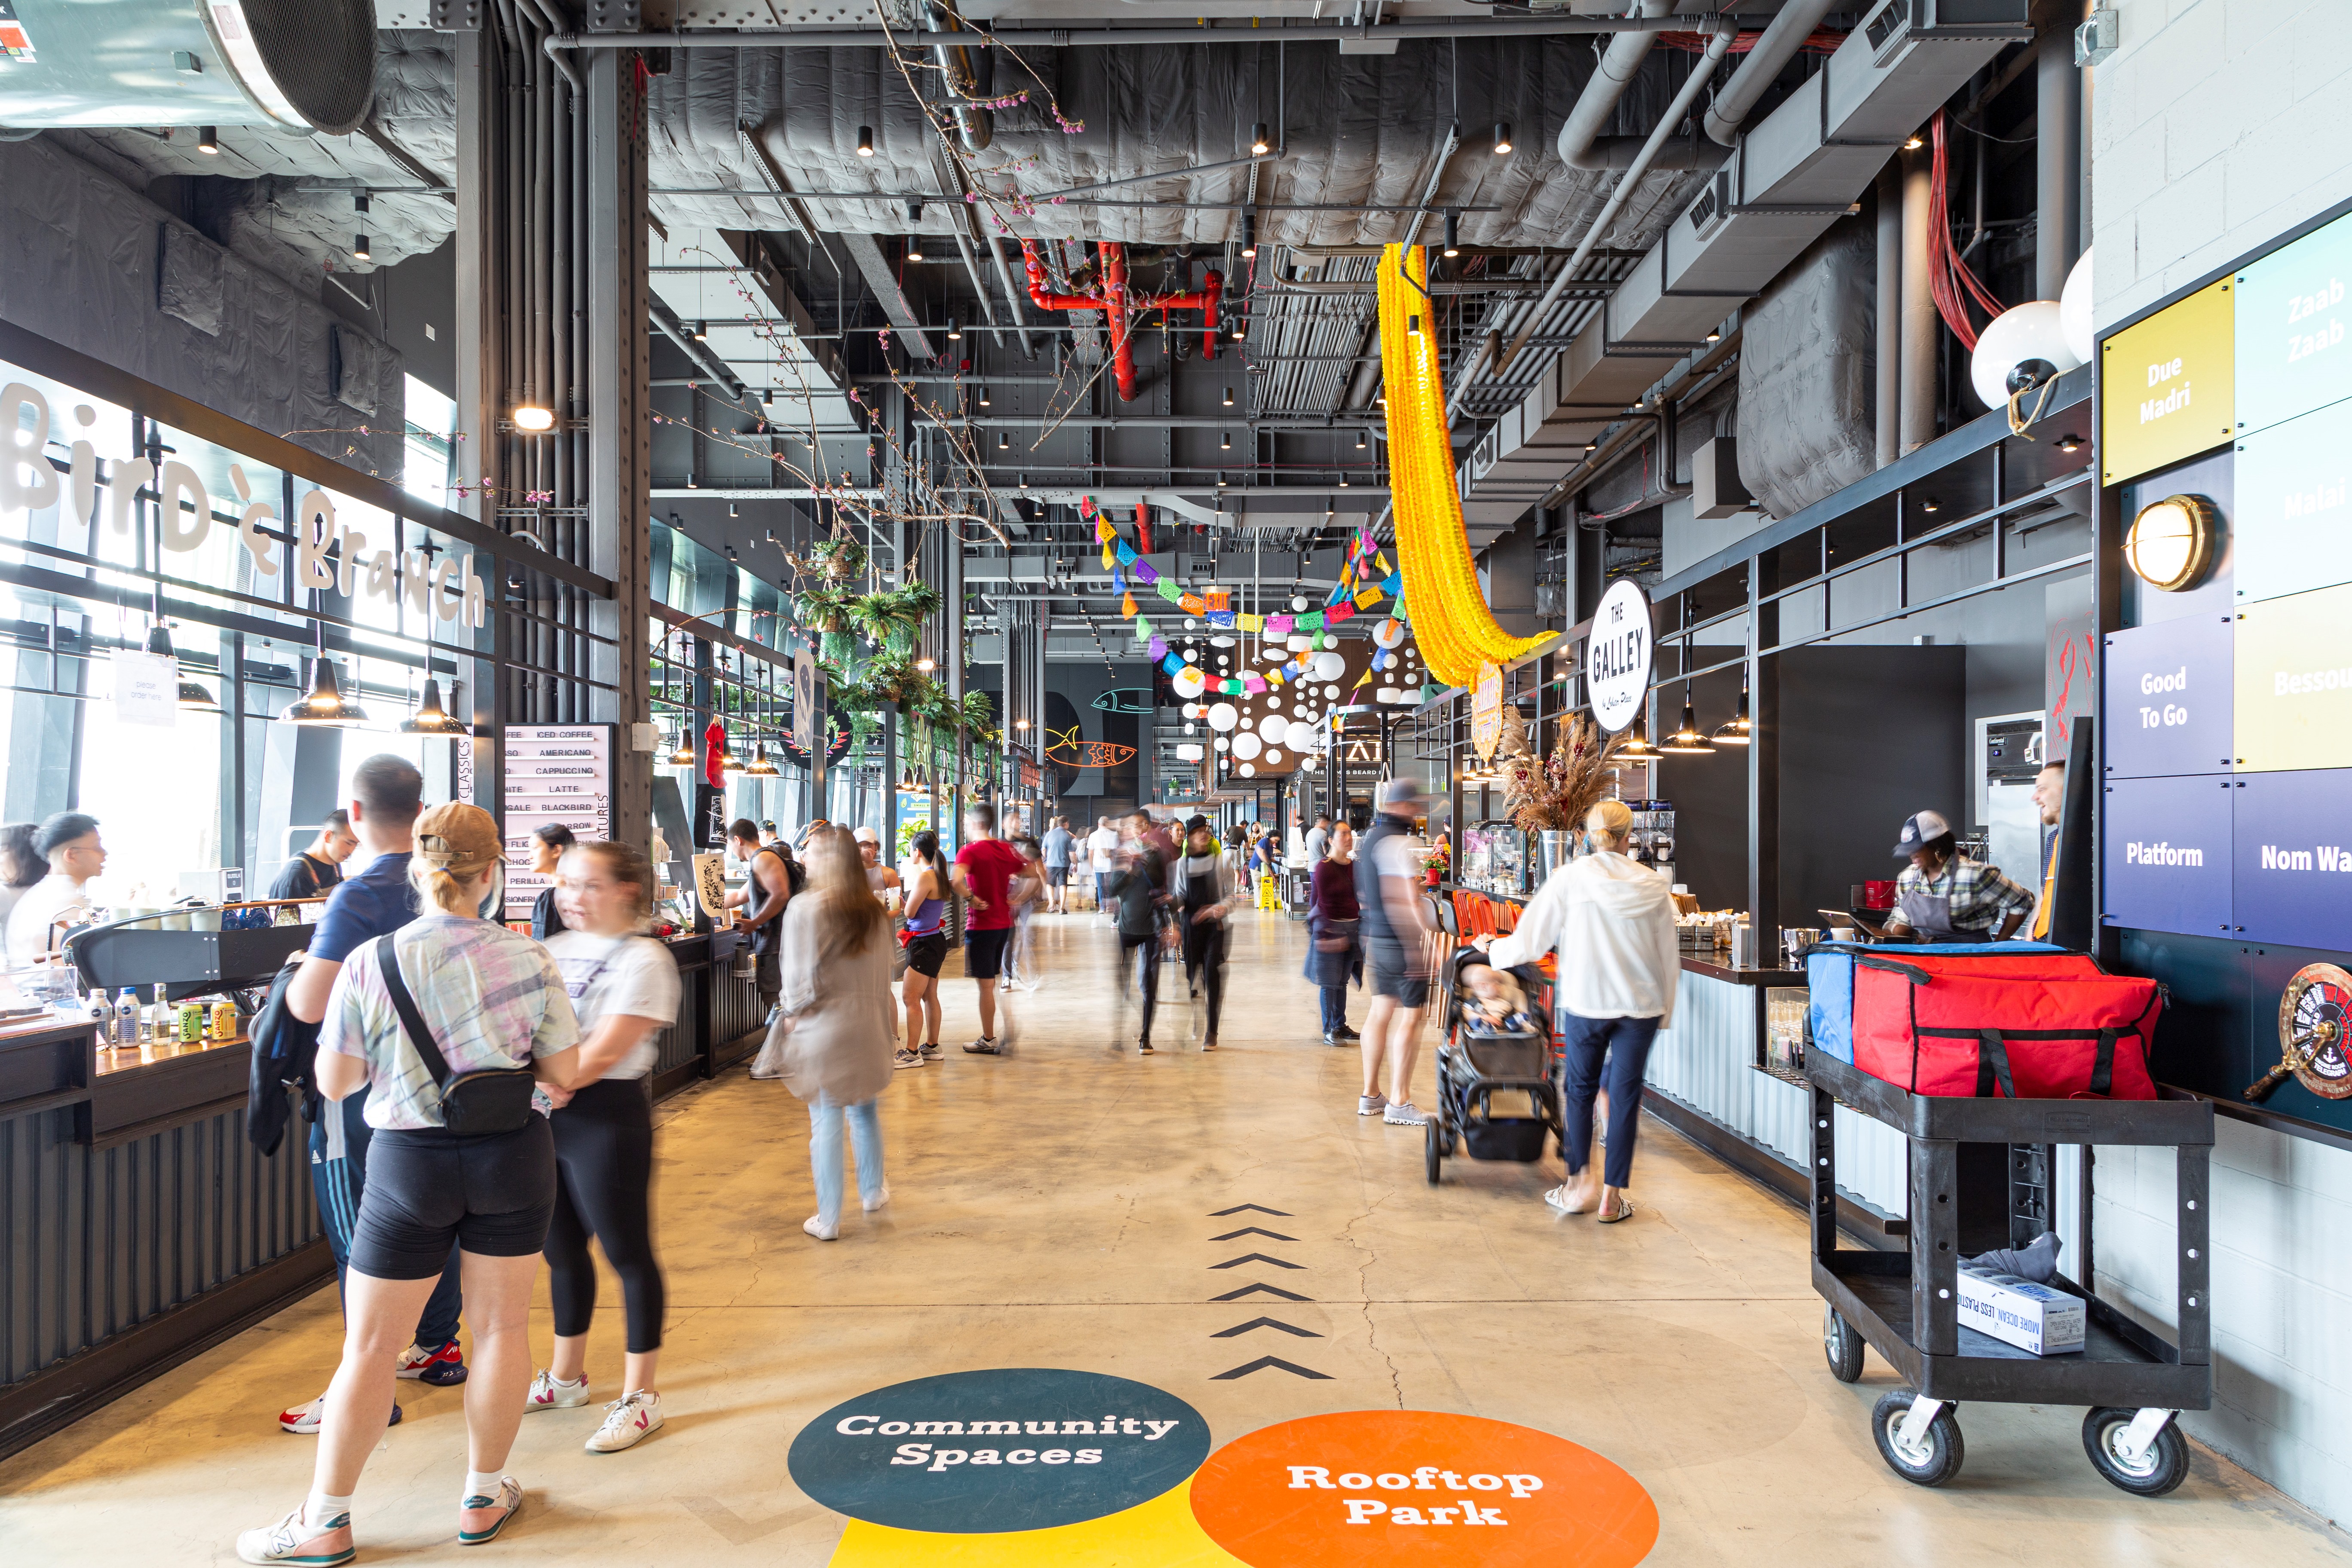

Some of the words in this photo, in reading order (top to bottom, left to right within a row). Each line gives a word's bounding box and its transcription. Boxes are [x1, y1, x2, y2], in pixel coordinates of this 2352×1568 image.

[2288, 278, 2344, 324] Zaab
[2288, 318, 2344, 364] Zaab
[2148, 358, 2182, 387] Due
[2140, 382, 2190, 425] Madri
[2285, 477, 2346, 520] Malai
[1206, 593, 1229, 609] EXIT
[1611, 602, 1623, 624] THE
[1593, 627, 1643, 684] GALLEY
[137, 681, 156, 689] please
[2141, 666, 2187, 695] Good
[2274, 668, 2352, 696] Bessou
[149, 692, 162, 701] here
[1620, 692, 1632, 707] Place
[2139, 707, 2159, 729] To
[2163, 704, 2187, 726] Go
[459, 741, 469, 799] CLASSICS
[565, 822, 591, 830] ARROW
[597, 795, 609, 841] ATURES
[2127, 841, 2203, 867] Platform
[2262, 845, 2312, 870] Nom
[182, 1011, 191, 1039] SANZO
[214, 1009, 223, 1037] SANZO
[2297, 1009, 2311, 1025] SLOW
[2314, 1057, 2331, 1070] ENGINE
[2331, 1062, 2346, 1070] ROOM
[2314, 1062, 2347, 1077] TELEGRAPH
[2301, 1072, 2323, 1091] BERGEN
[2327, 1083, 2351, 1093] NORWAY
[1981, 1304, 1995, 1318] LESS
[2020, 1317, 2040, 1335] MORE
[835, 1414, 1180, 1440] Community
[889, 1443, 1103, 1471] Spaces
[1286, 1465, 1544, 1498] Rooftop
[1342, 1499, 1508, 1525] Park
